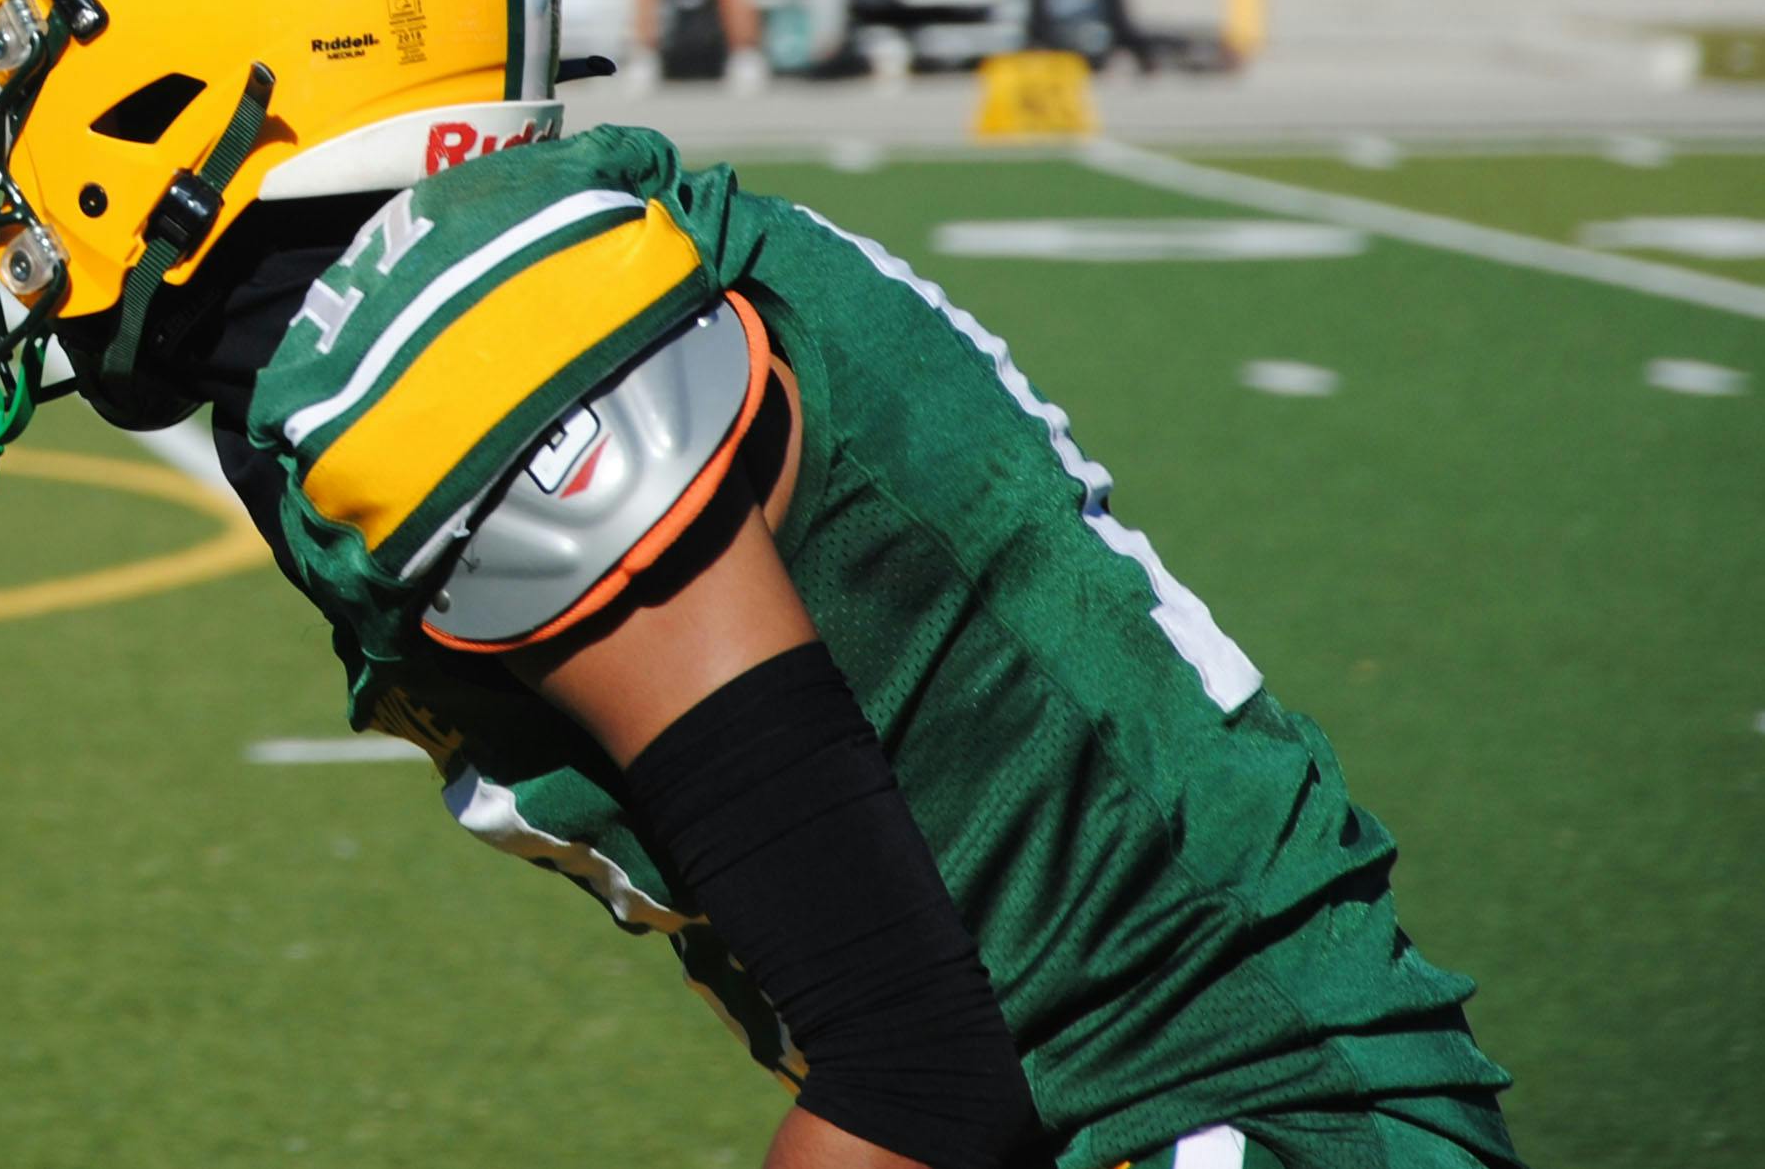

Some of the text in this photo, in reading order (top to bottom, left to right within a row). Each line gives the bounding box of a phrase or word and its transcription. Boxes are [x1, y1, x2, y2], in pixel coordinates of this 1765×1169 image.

[311, 33, 374, 52] Riddell
[327, 49, 366, 60] MEDIUM
[288, 187, 435, 355] 17
